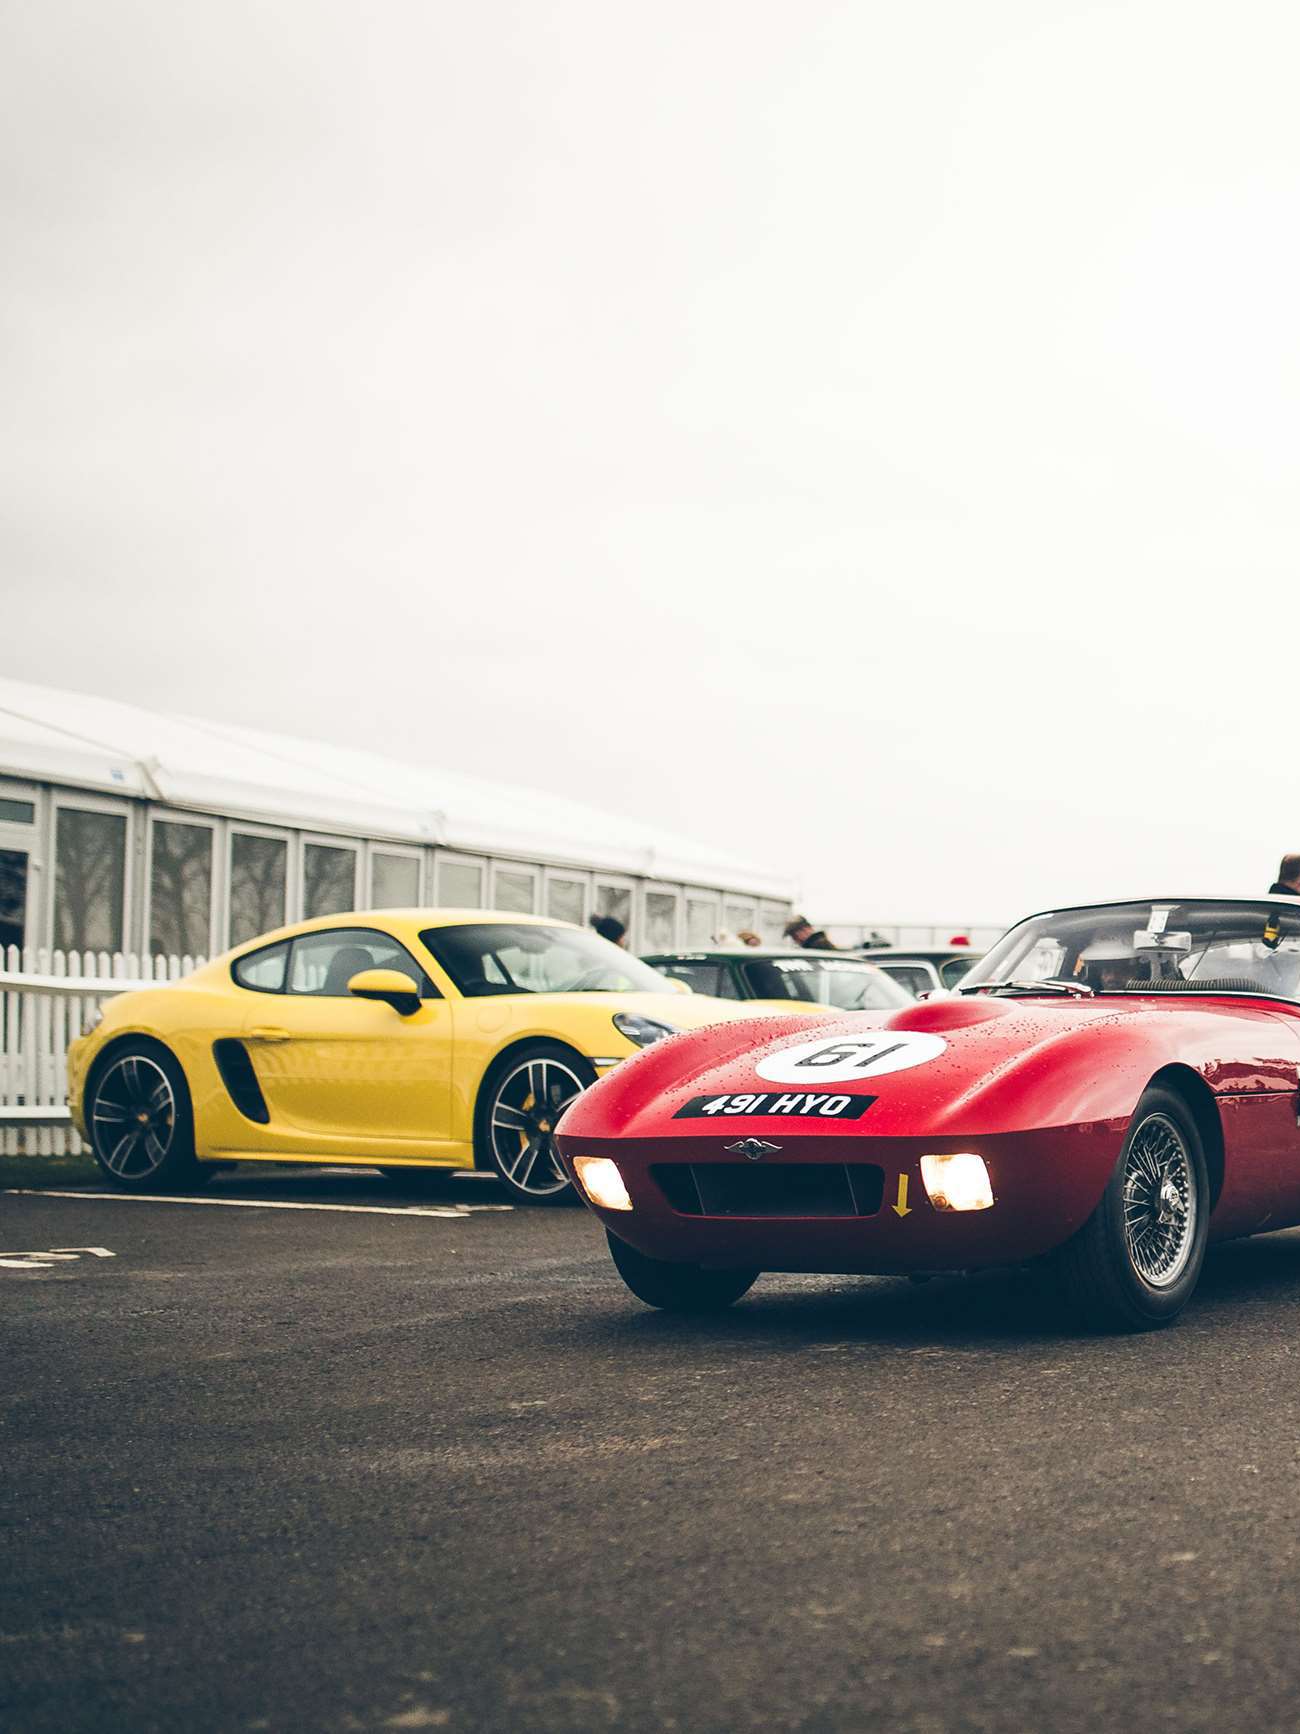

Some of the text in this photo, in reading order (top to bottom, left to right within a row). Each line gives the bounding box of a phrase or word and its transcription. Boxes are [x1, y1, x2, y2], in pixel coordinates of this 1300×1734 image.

[794, 1042, 909, 1068] 61
[702, 1094, 851, 1115] 491 HYO
